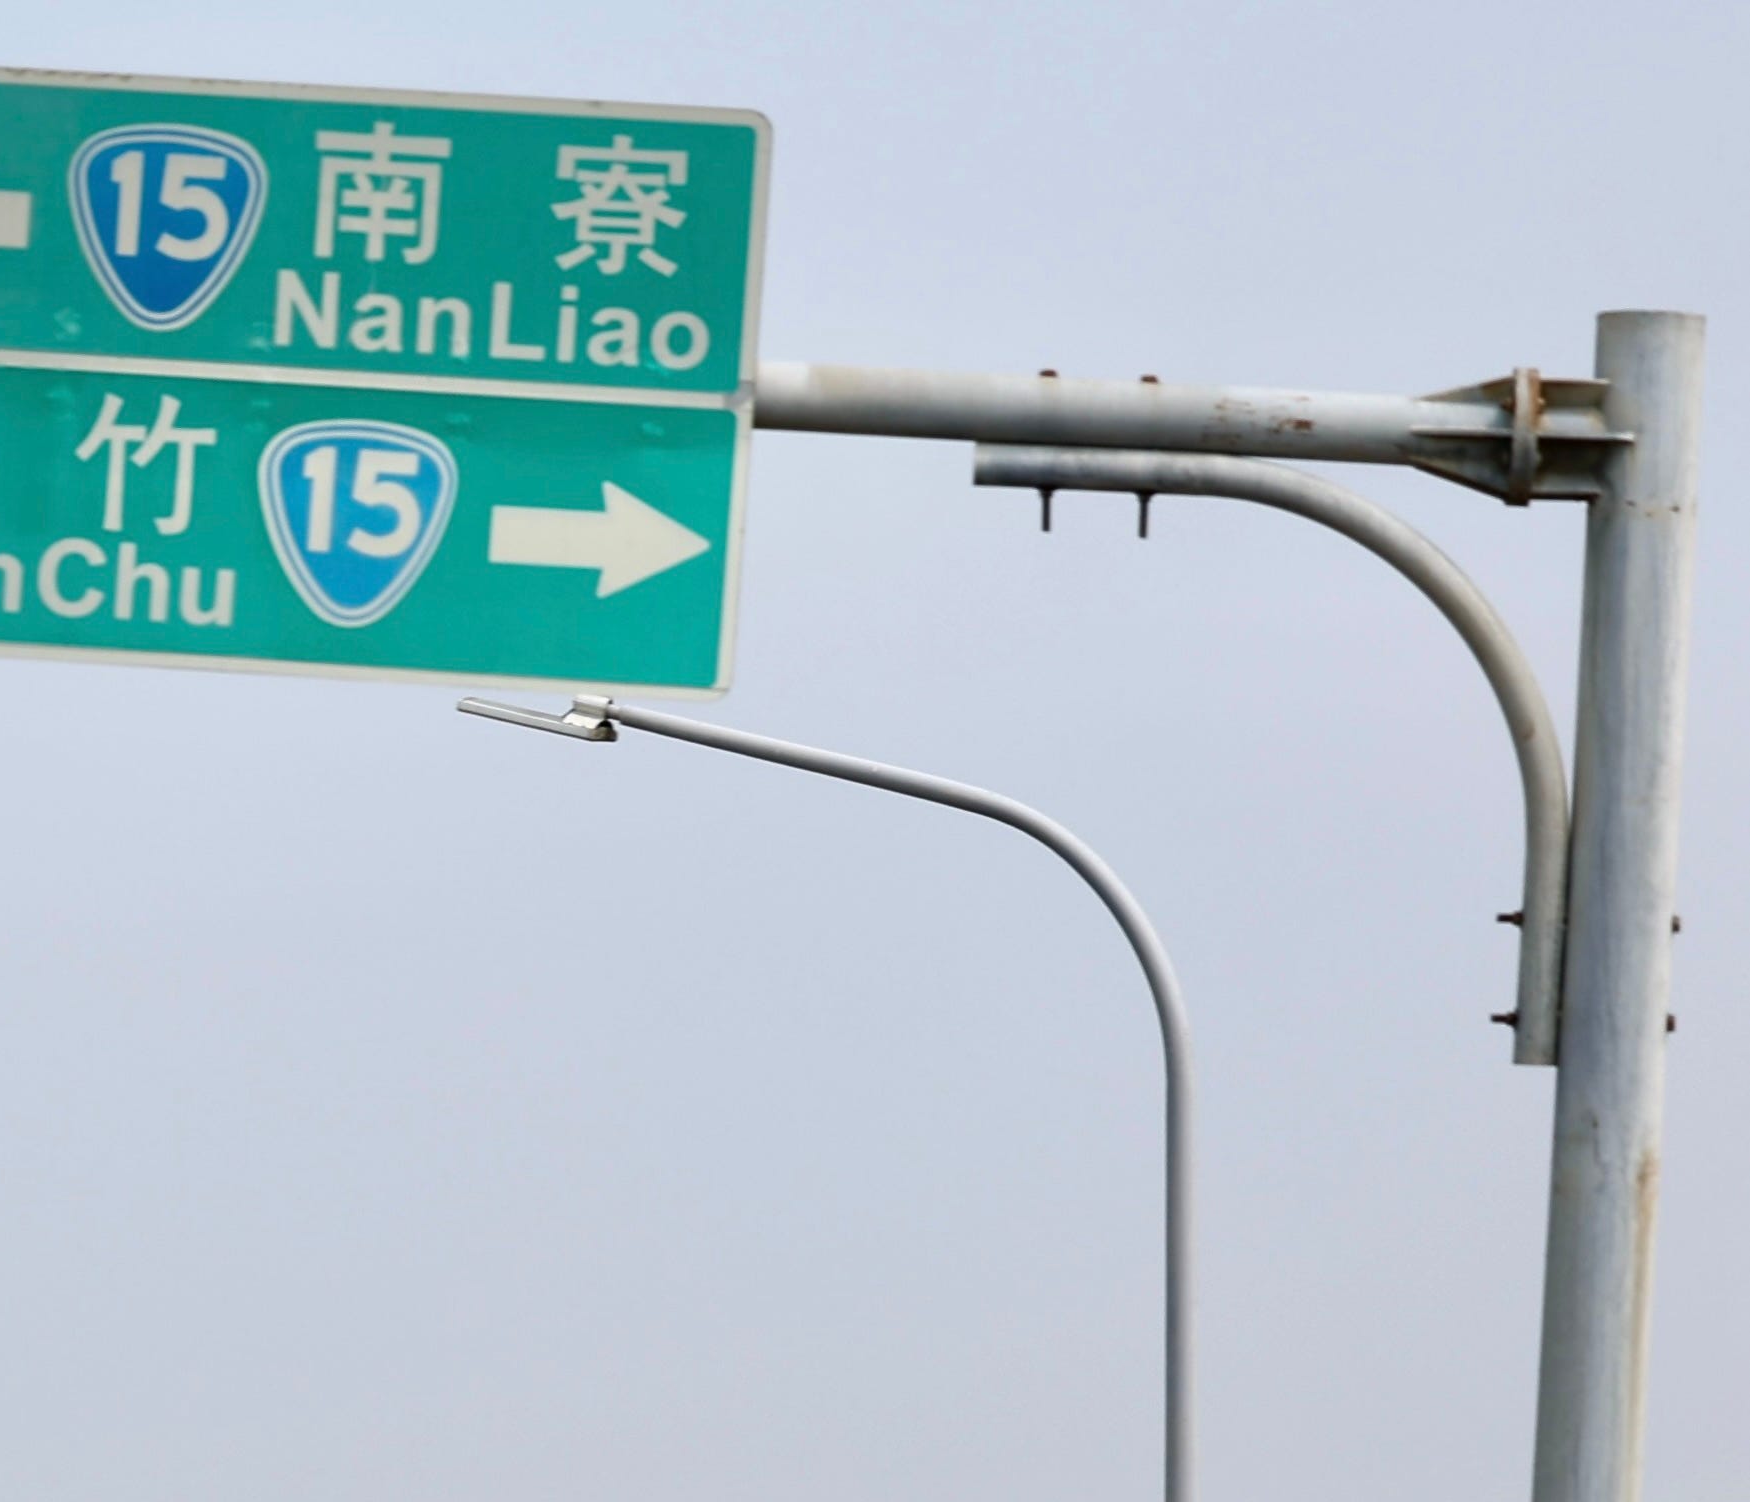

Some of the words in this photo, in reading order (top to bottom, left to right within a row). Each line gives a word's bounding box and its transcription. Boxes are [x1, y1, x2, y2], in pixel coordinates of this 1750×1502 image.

[110, 150, 229, 261] 15
[314, 121, 688, 277] 南寮
[274, 269, 710, 370] NanLiao
[303, 445, 422, 559] 15
